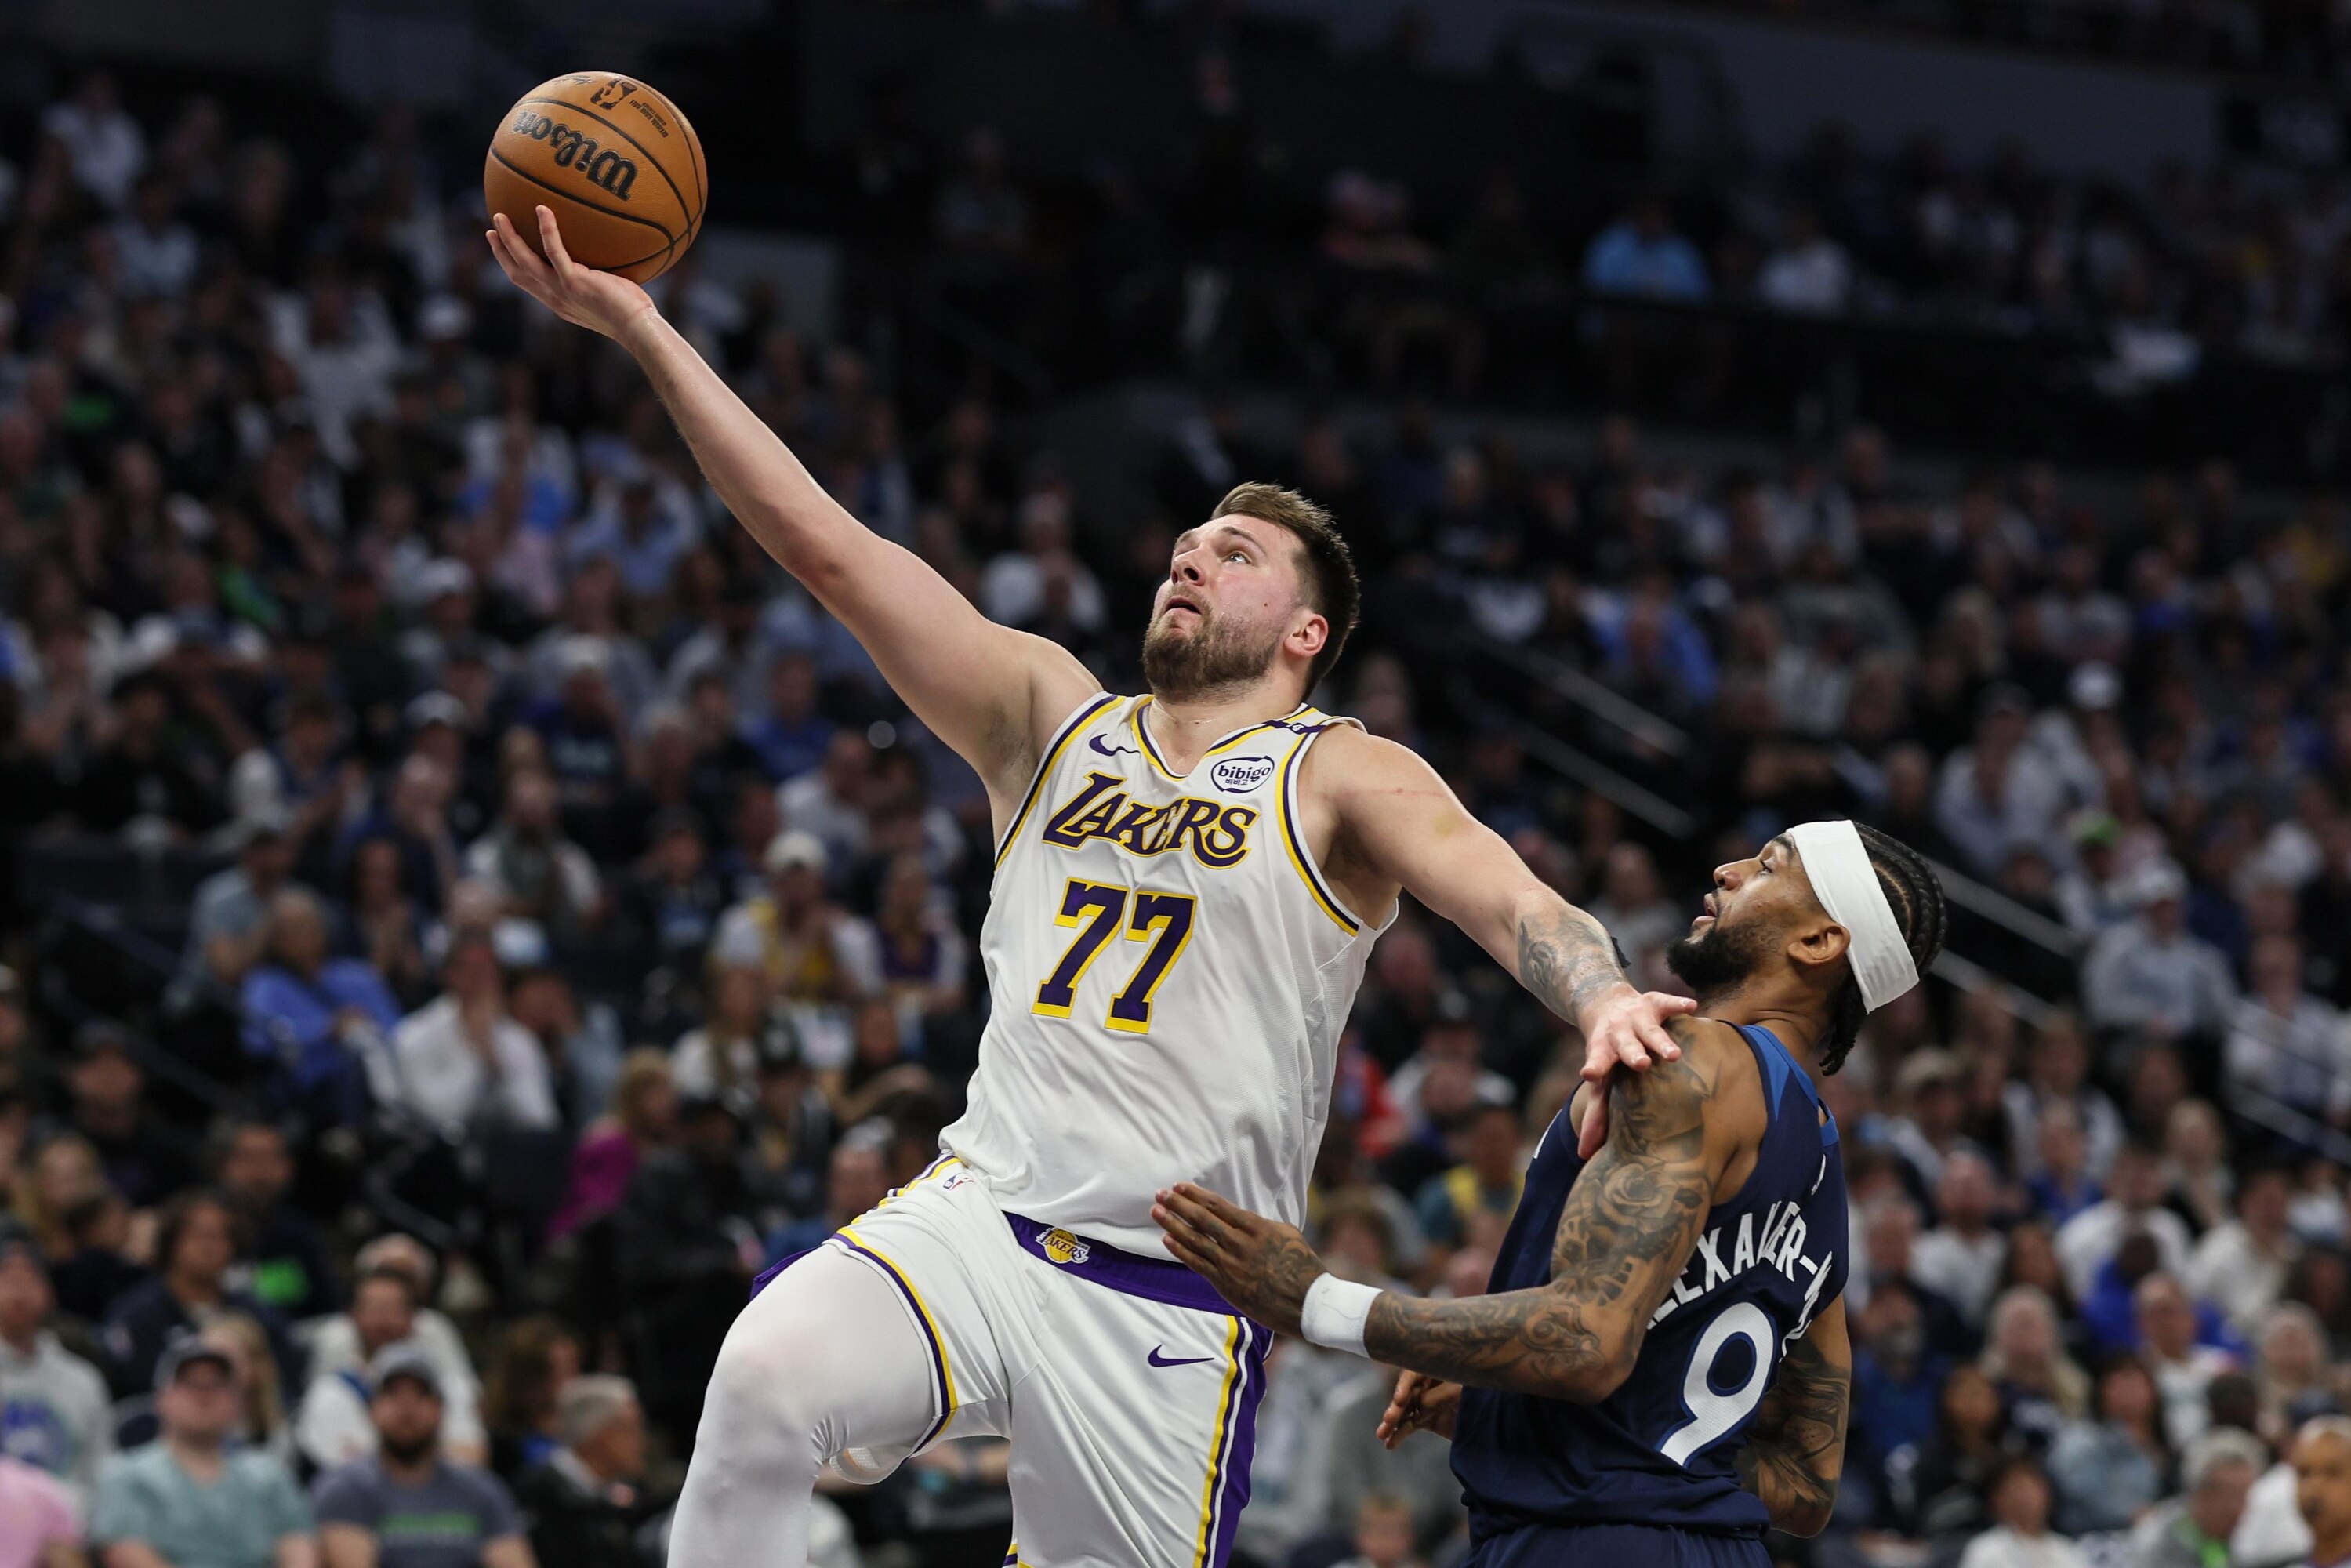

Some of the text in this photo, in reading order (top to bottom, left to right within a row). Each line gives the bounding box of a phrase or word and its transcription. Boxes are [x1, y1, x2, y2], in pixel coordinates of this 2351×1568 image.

[513, 111, 638, 202] Wilson
[1042, 771, 1260, 870] LAKERS
[1218, 764, 1272, 782] bibigo
[1031, 877, 1198, 1035] 77
[1039, 1230, 1089, 1262] LAKERS
[1658, 1301, 1776, 1467] 9
